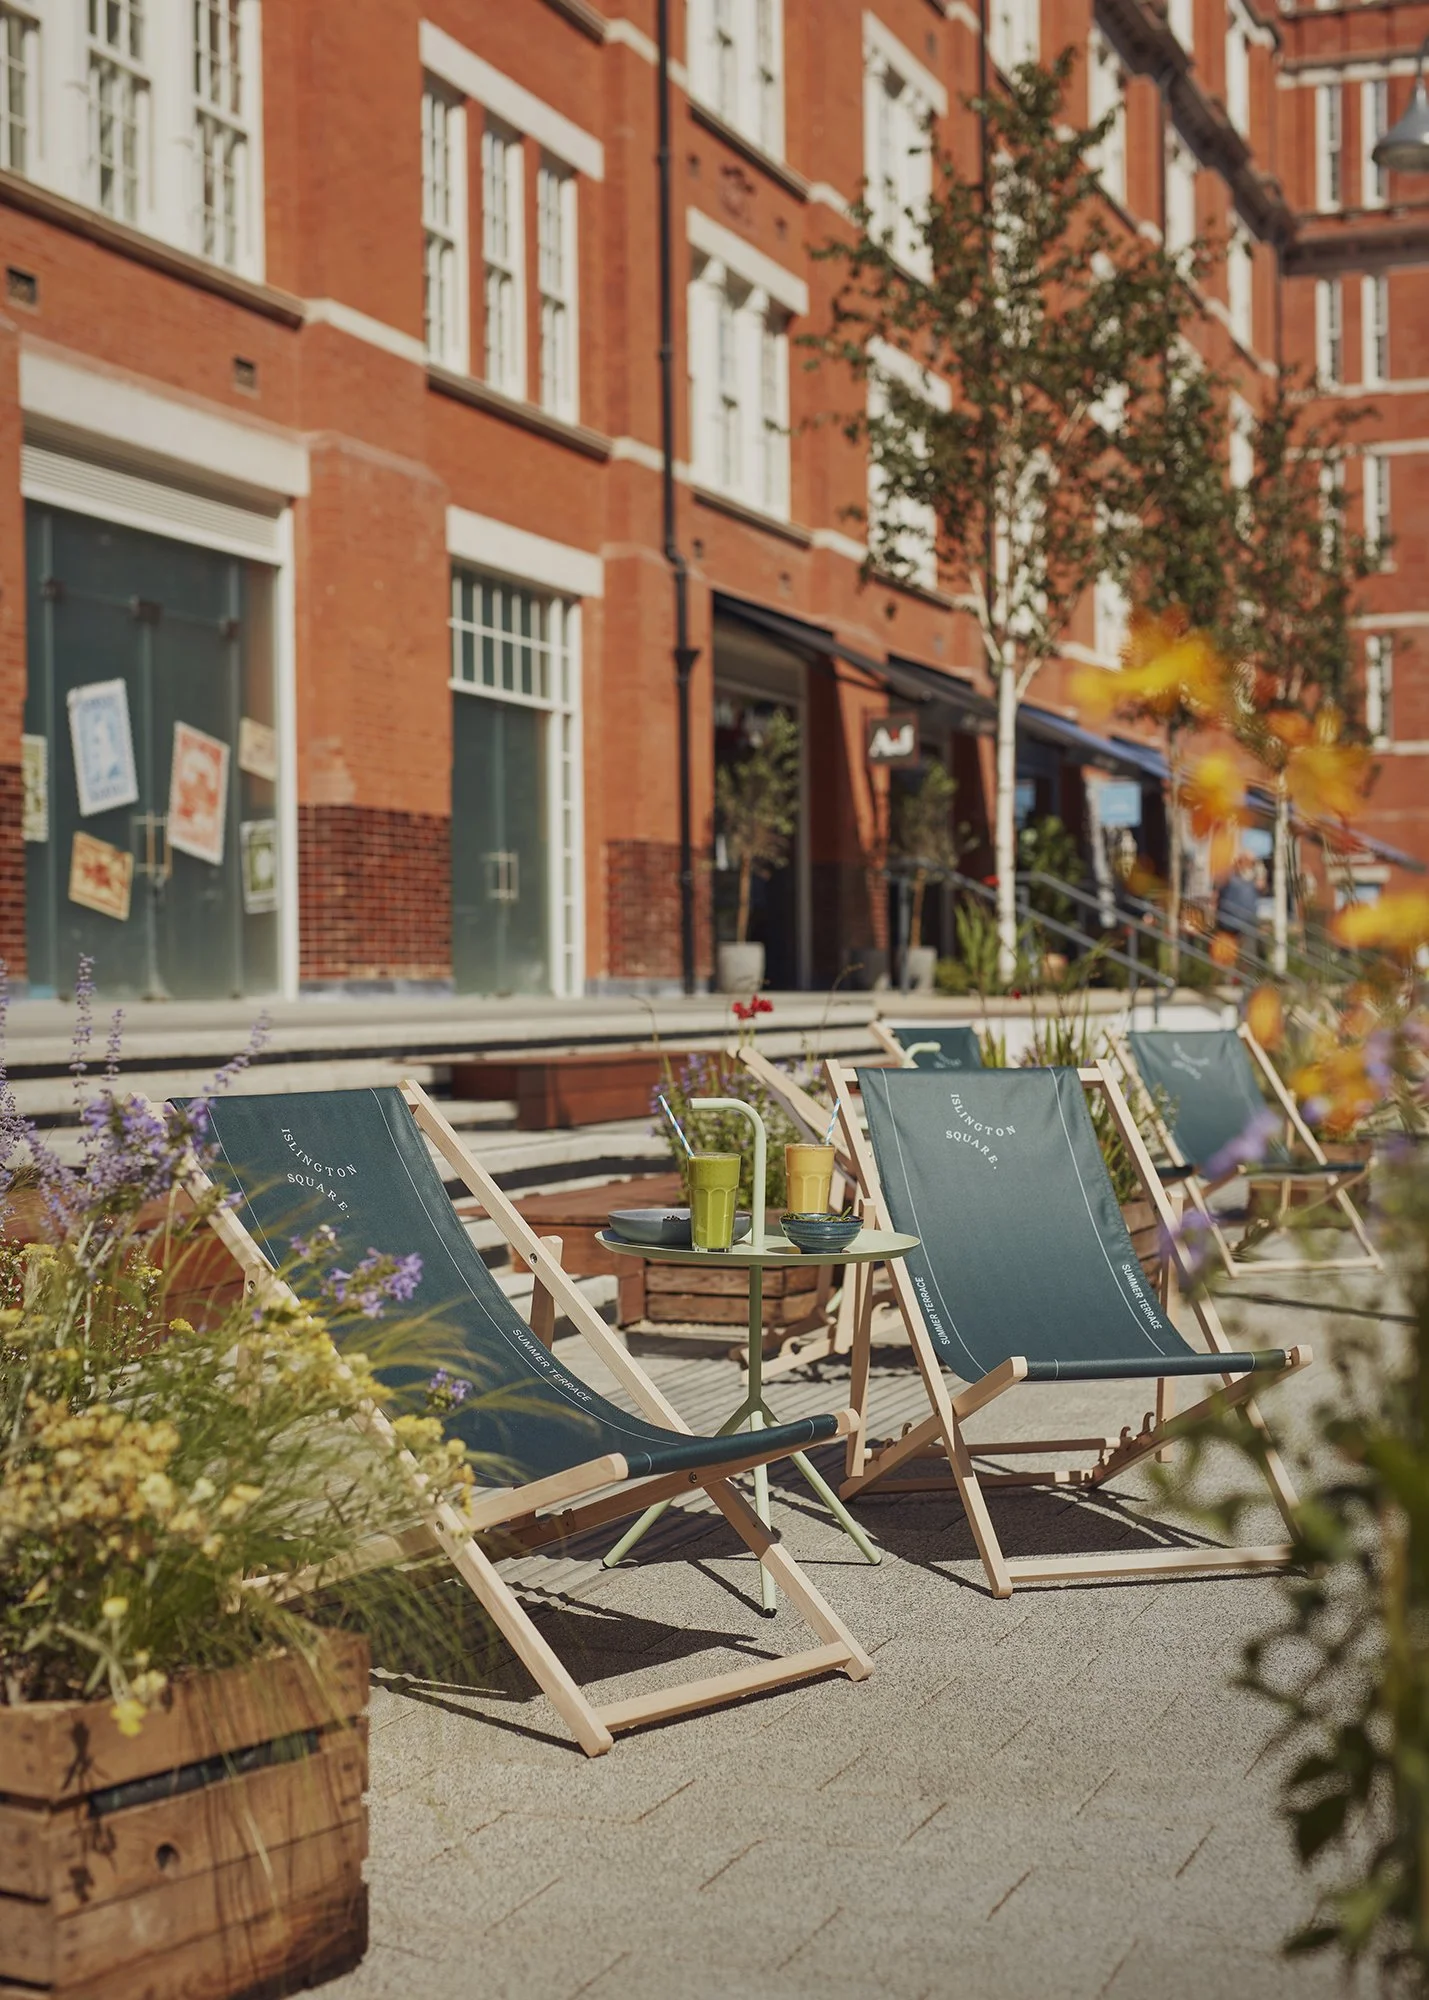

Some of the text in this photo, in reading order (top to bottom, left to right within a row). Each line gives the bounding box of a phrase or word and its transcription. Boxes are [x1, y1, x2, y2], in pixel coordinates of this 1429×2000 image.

[950, 1093, 1016, 1137] ISLINGTON
[281, 1128, 357, 1178] ISLINGTON
[945, 1130, 998, 1170] SQUARE.
[287, 1173, 350, 1219] SQUARE.
[914, 1276, 951, 1346] SUMMER TERRACE
[1121, 1264, 1163, 1330] SUMMER TERRACE
[512, 1329, 593, 1402] SUMMER TERRACE
